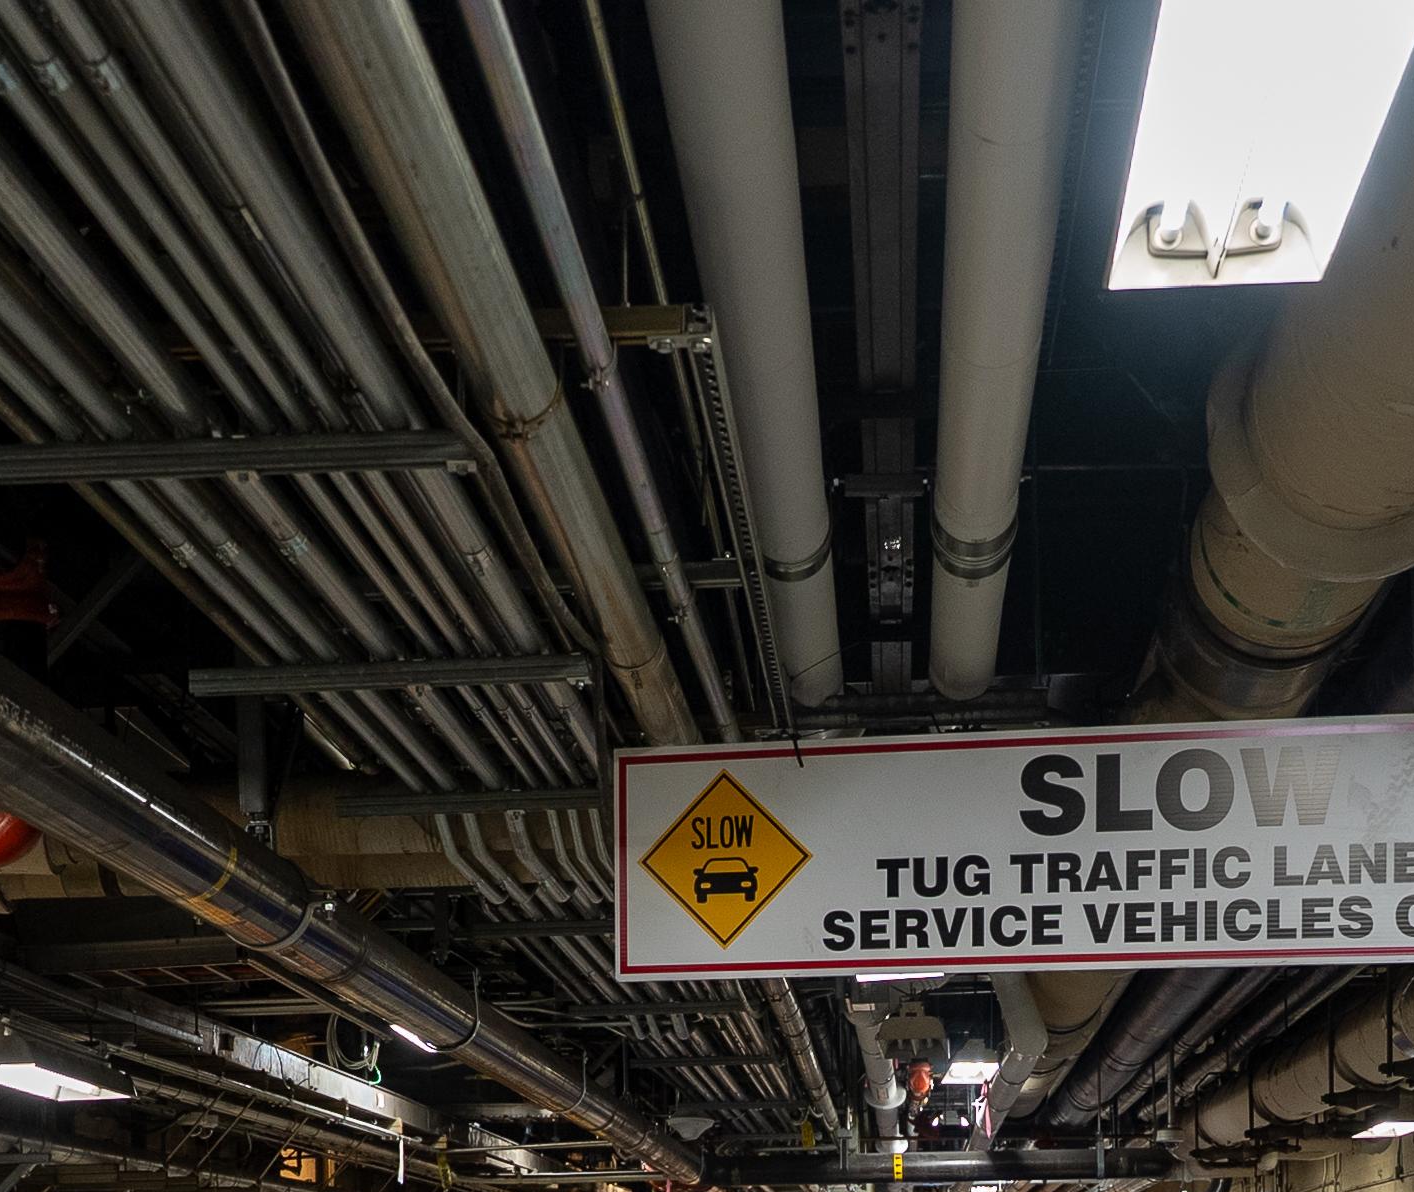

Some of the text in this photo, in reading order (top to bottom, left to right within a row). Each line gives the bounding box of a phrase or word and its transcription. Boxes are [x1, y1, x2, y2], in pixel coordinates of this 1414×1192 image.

[1020, 749, 1344, 838] SLOW
[691, 815, 755, 851] SLOW
[875, 854, 991, 899] TUG
[1009, 846, 1252, 896] TRAFFIC
[822, 905, 1064, 951] SERVICE
[1082, 896, 1378, 944] VEHICLES
